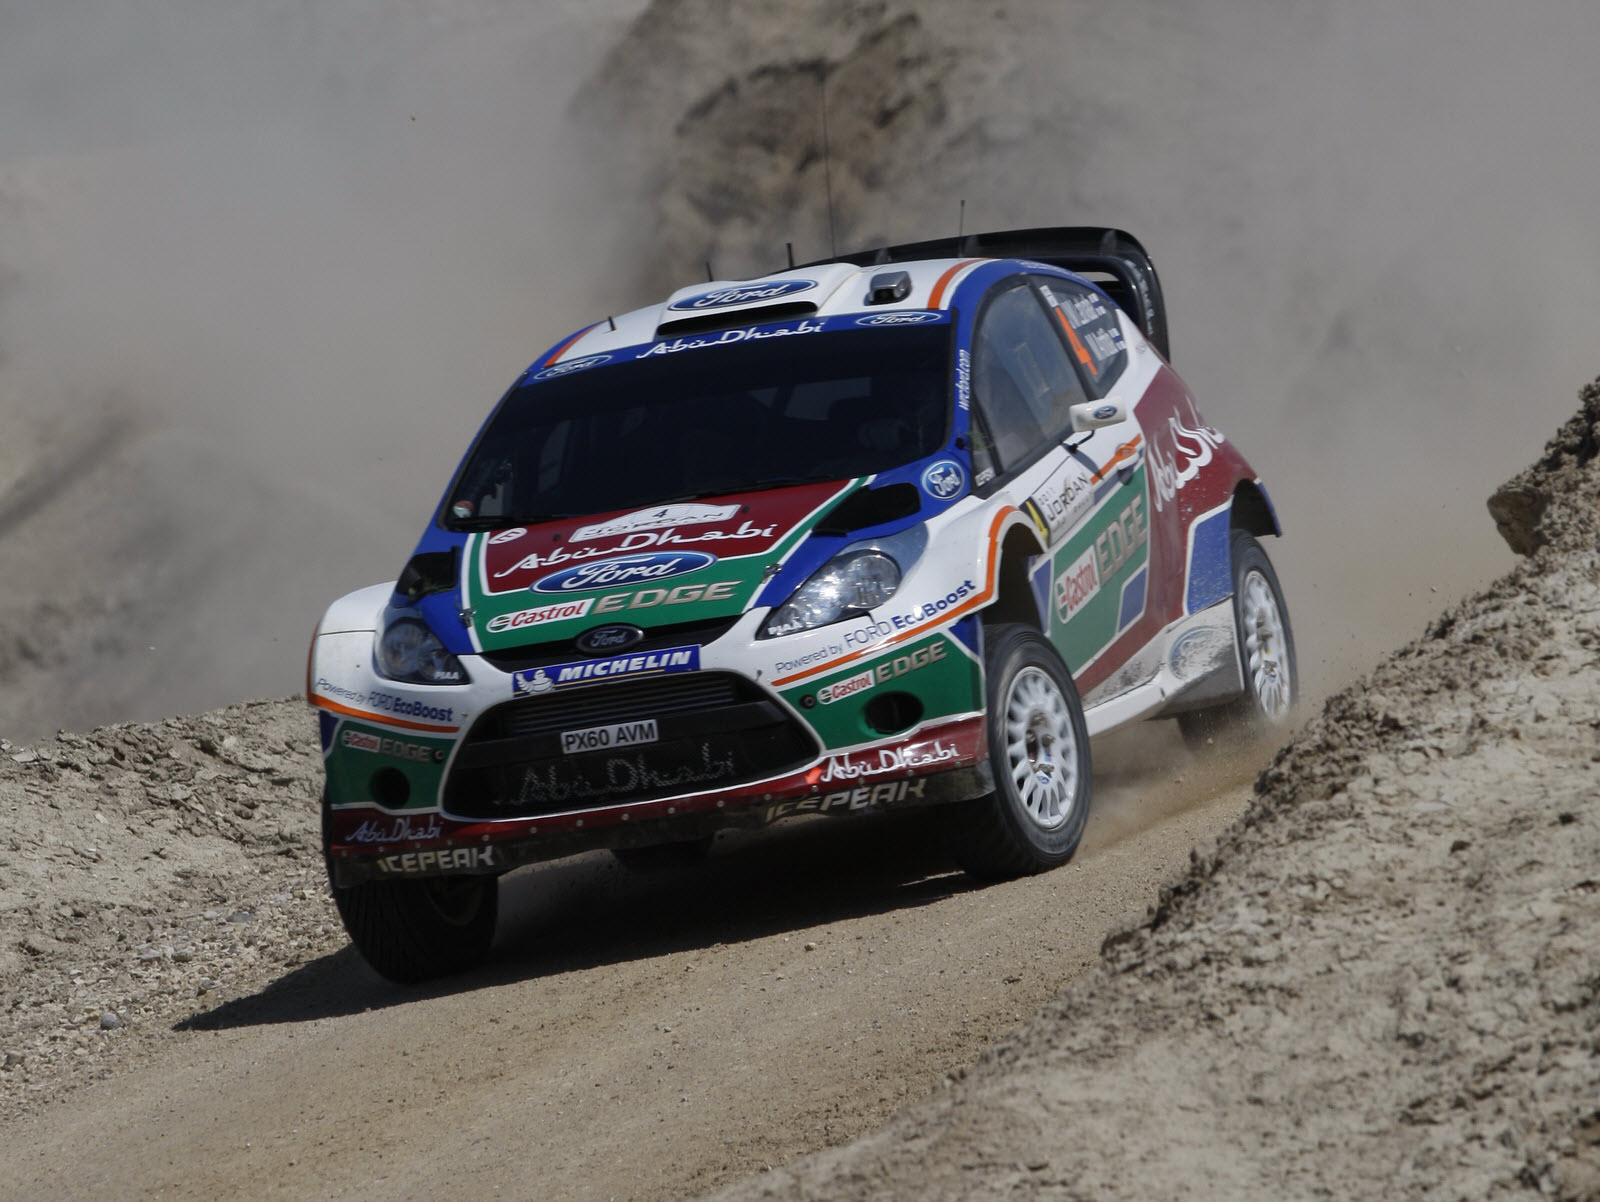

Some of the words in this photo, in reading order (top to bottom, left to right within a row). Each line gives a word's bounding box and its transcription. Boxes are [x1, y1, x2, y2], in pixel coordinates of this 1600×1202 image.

[696, 281, 792, 308] Ford
[704, 321, 823, 346] Dhabi
[868, 312, 924, 326] Ford
[928, 466, 961, 496] Ford
[652, 504, 669, 518] 4
[494, 547, 602, 577] Abu
[604, 520, 778, 553] Dhabi
[1095, 494, 1148, 585] EDGE
[561, 556, 683, 589] Ford
[510, 601, 586, 628] Castrol
[592, 580, 743, 615] EDGE
[589, 629, 627, 647] Ford
[775, 647, 828, 673] Powered
[828, 644, 843, 656] by
[843, 621, 892, 649] FORD
[891, 579, 977, 630] EcoBoost
[434, 670, 459, 681] PIAA
[557, 650, 692, 683] MICHELIN
[831, 674, 872, 699] Castrol
[875, 640, 948, 684] EDGE
[318, 678, 357, 700] Powered
[392, 697, 454, 722] EcoBoost
[380, 738, 432, 763] EDGE
[564, 729, 610, 751] PX60
[615, 722, 656, 744] AVM
[766, 779, 928, 823] ICEPEAK
[391, 815, 444, 841] Dhabi
[377, 845, 495, 872] ICEPEAK
